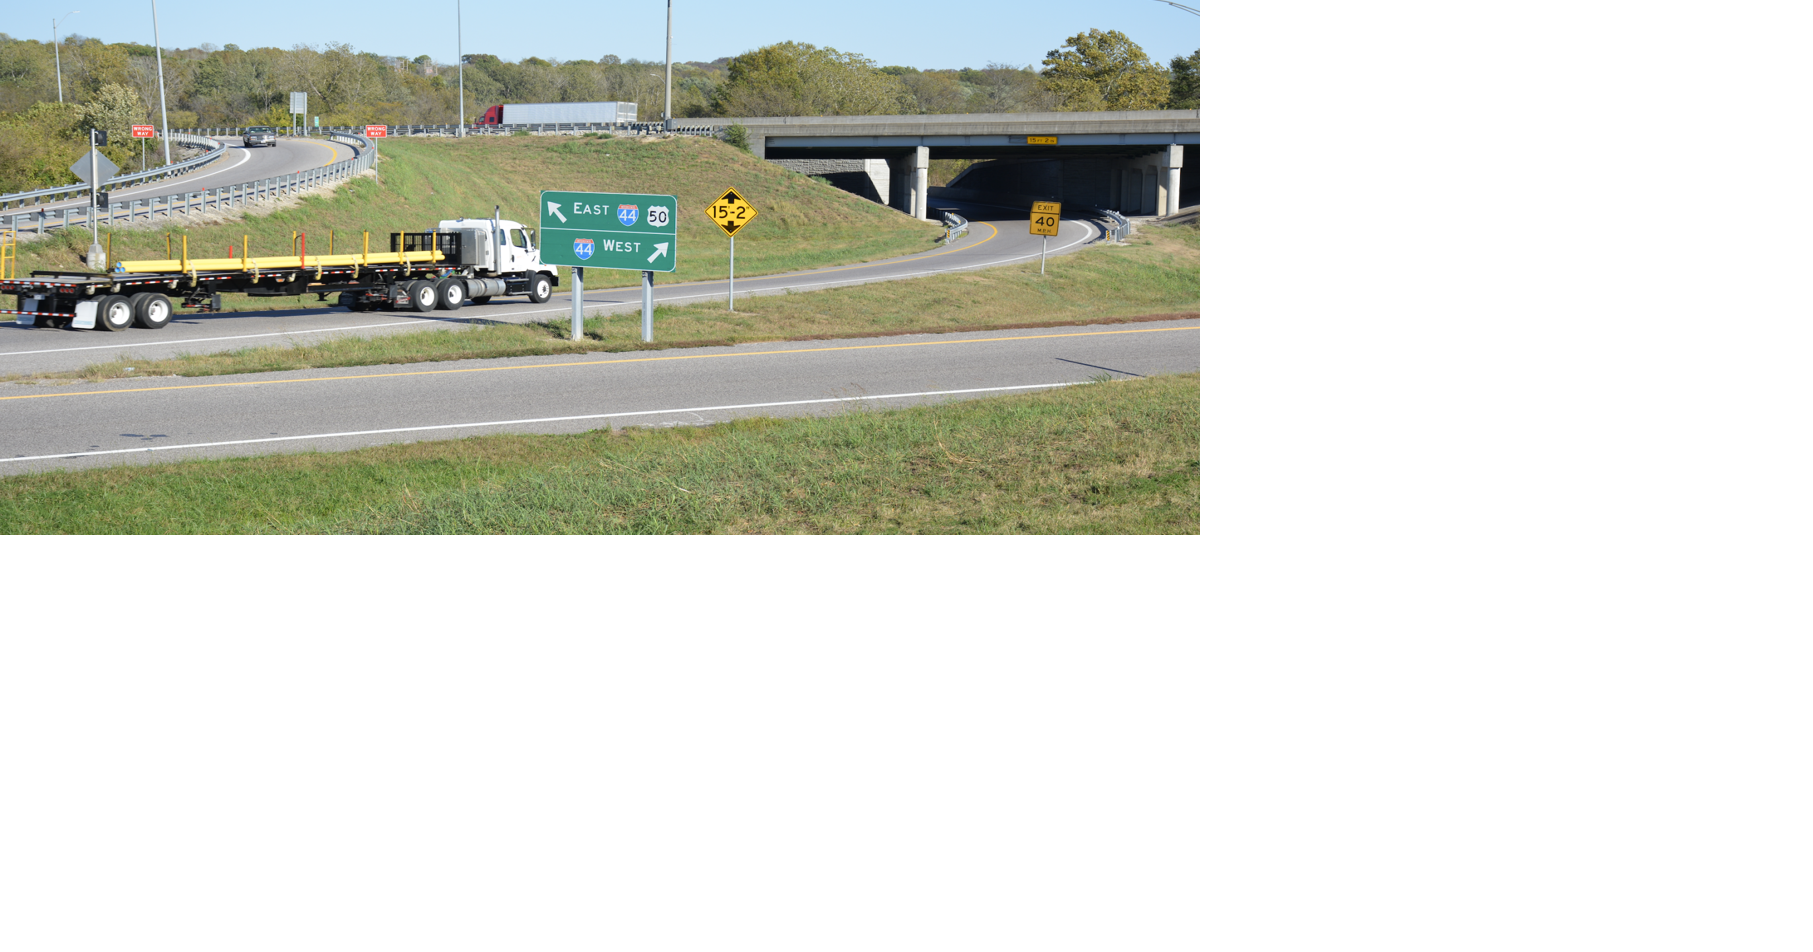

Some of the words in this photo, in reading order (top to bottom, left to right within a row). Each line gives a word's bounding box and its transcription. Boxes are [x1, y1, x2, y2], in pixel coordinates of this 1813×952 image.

[573, 202, 610, 216] EAST
[619, 210, 637, 222] 44
[649, 210, 667, 223] 50
[1035, 216, 1055, 227] 40
[575, 243, 593, 256] 44
[603, 239, 642, 253] WEST
